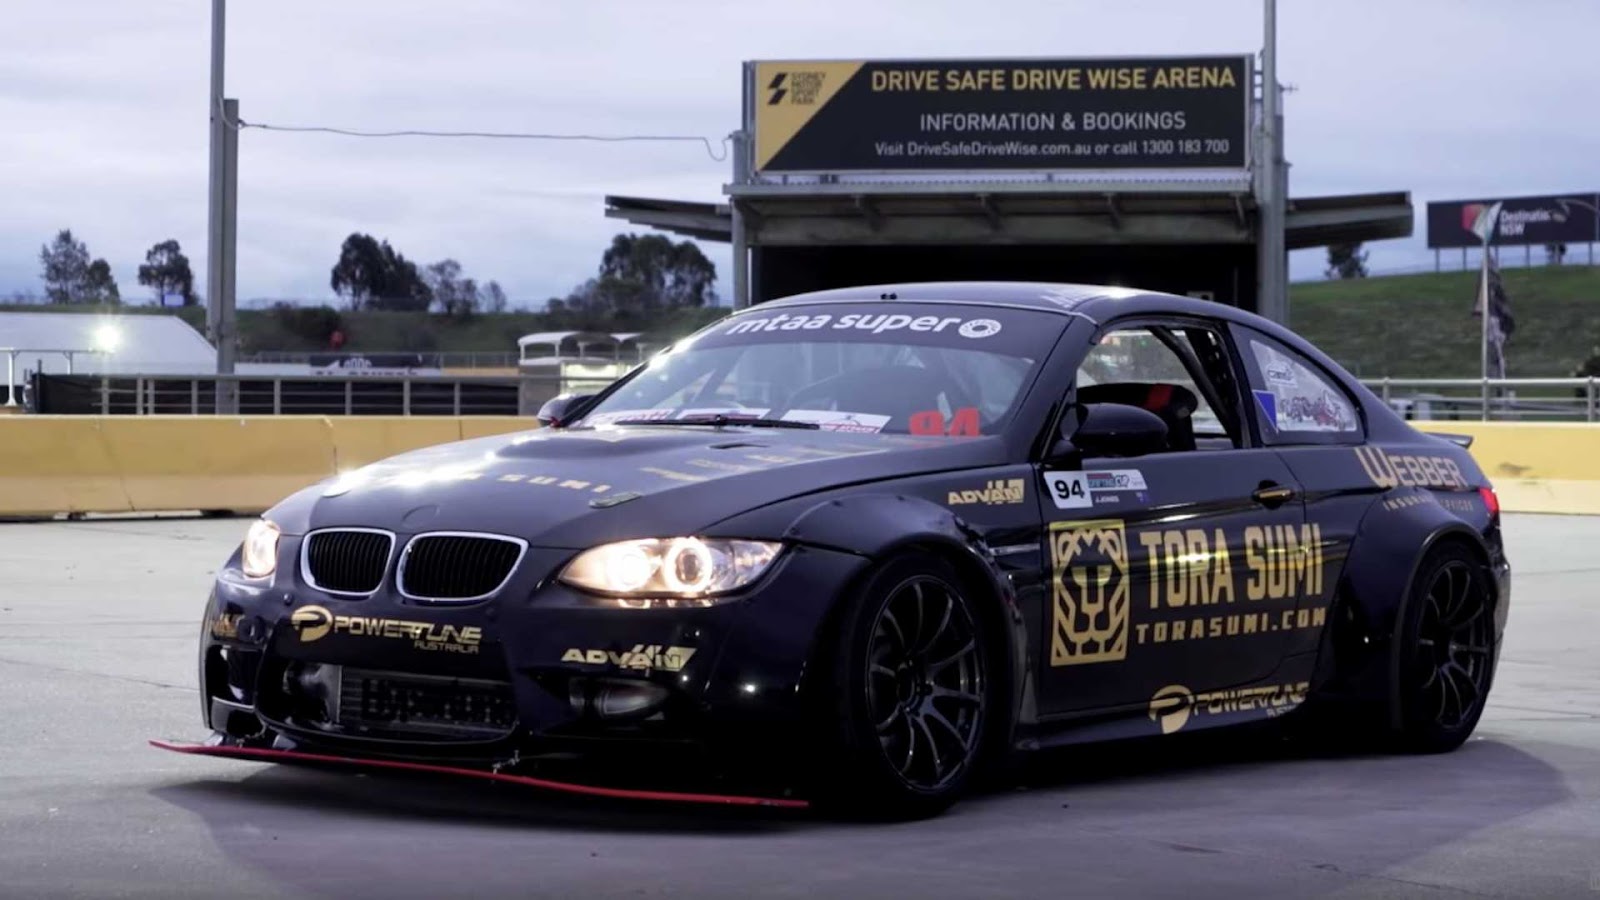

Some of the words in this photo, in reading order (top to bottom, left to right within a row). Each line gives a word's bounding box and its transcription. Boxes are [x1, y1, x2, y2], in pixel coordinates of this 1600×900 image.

[872, 70, 940, 91] DRIVE
[945, 70, 1006, 90] SAFE
[1012, 69, 1081, 90] DRIVE
[1087, 68, 1147, 89] WISE
[1153, 66, 1236, 88] ARENA
[920, 113, 1055, 131] INFORMATION
[1061, 112, 1075, 130] &
[1083, 111, 1187, 130] BOOKINGS
[875, 142, 903, 155] Visit
[907, 141, 1091, 155] DriveSafeDriveWise.com.au
[1094, 143, 1109, 155] or
[1112, 140, 1138, 154] call
[1142, 140, 1173, 154] 1300
[1177, 139, 1200, 153] 183
[1205, 139, 1229, 153] 700
[726, 314, 829, 335] mtaa
[832, 313, 961, 334] super
[948, 479, 1024, 506] ADVAN
[1054, 480, 1085, 499] 94
[1139, 528, 1235, 609] TORA
[1243, 523, 1324, 601] SUMI
[335, 616, 483, 642] POWERTUNE
[1135, 606, 1326, 645] TORASUMI.COM
[414, 639, 479, 654] AUSTRALIA
[561, 645, 697, 674] ADVAN
